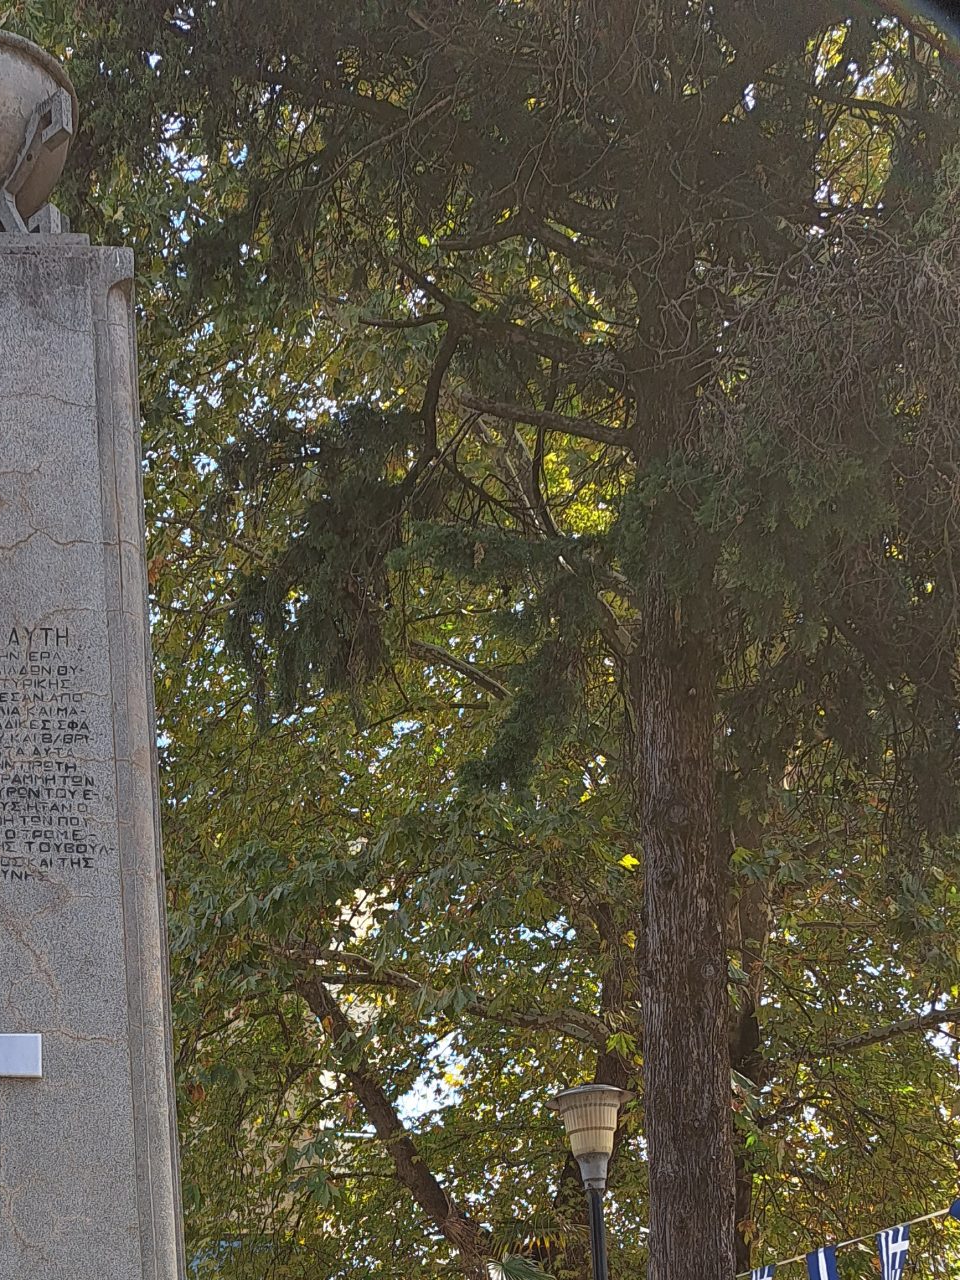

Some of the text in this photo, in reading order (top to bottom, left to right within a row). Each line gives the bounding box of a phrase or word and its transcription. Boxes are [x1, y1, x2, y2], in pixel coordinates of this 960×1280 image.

[8, 626, 69, 648] ΑΥΤΗ
[48, 692, 83, 704] ΑΠΟ
[26, 706, 52, 718] ΚΑΙ
[10, 733, 37, 744] ΚΑΙ
[32, 746, 75, 758] ΑΥΤΑ
[57, 775, 95, 787] ΤΩΝ
[43, 788, 78, 800] ΤΟΥ
[77, 802, 88, 813] Ο
[19, 815, 53, 827] ΤΩΝ
[57, 816, 89, 828] ΠΟΥ
[57, 857, 95, 870] ΤΗΣ
